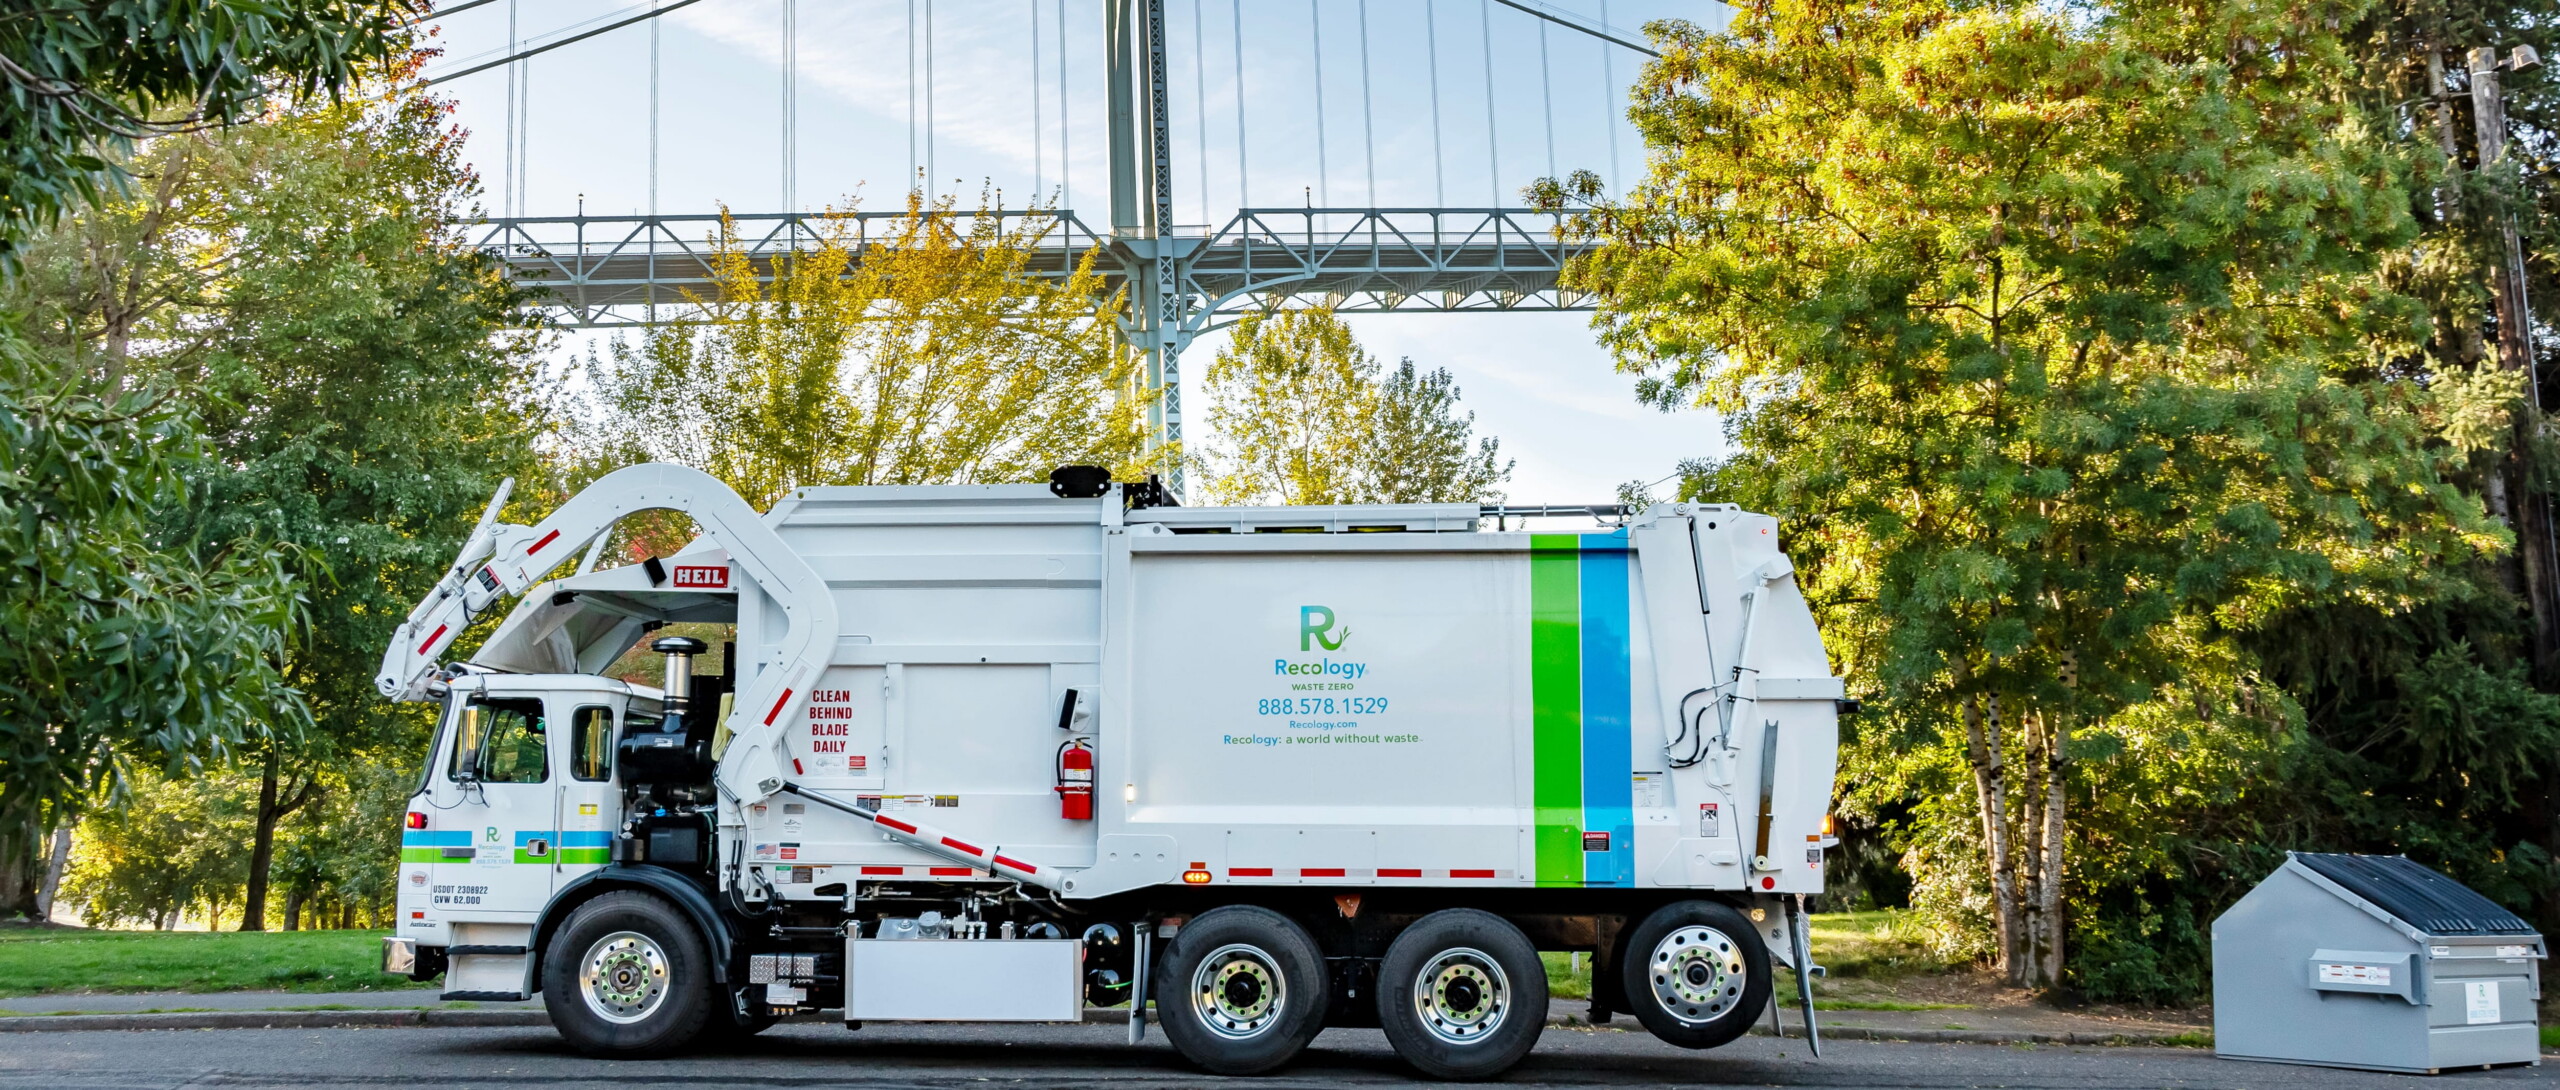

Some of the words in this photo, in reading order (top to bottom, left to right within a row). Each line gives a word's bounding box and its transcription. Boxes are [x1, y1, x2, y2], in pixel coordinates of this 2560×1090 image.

[676, 569, 724, 584] HEIL
[1275, 657, 1366, 680] Recology
[1291, 683, 1325, 691] WASTE
[1327, 683, 1354, 691] ZERO
[812, 690, 850, 703] CLEAN
[1258, 697, 1389, 715] 888.578.1529
[809, 707, 852, 719] BEHIND
[812, 723, 849, 736] BLADE
[1289, 720, 1358, 731] Recology.com
[1223, 734, 1282, 746] Recology:
[1285, 736, 1293, 744] a
[1296, 734, 1330, 744] world
[1334, 733, 1380, 744] without
[813, 740, 846, 753] DAILY
[433, 885, 455, 893] USDOT
[457, 885, 488, 894] 2308922
